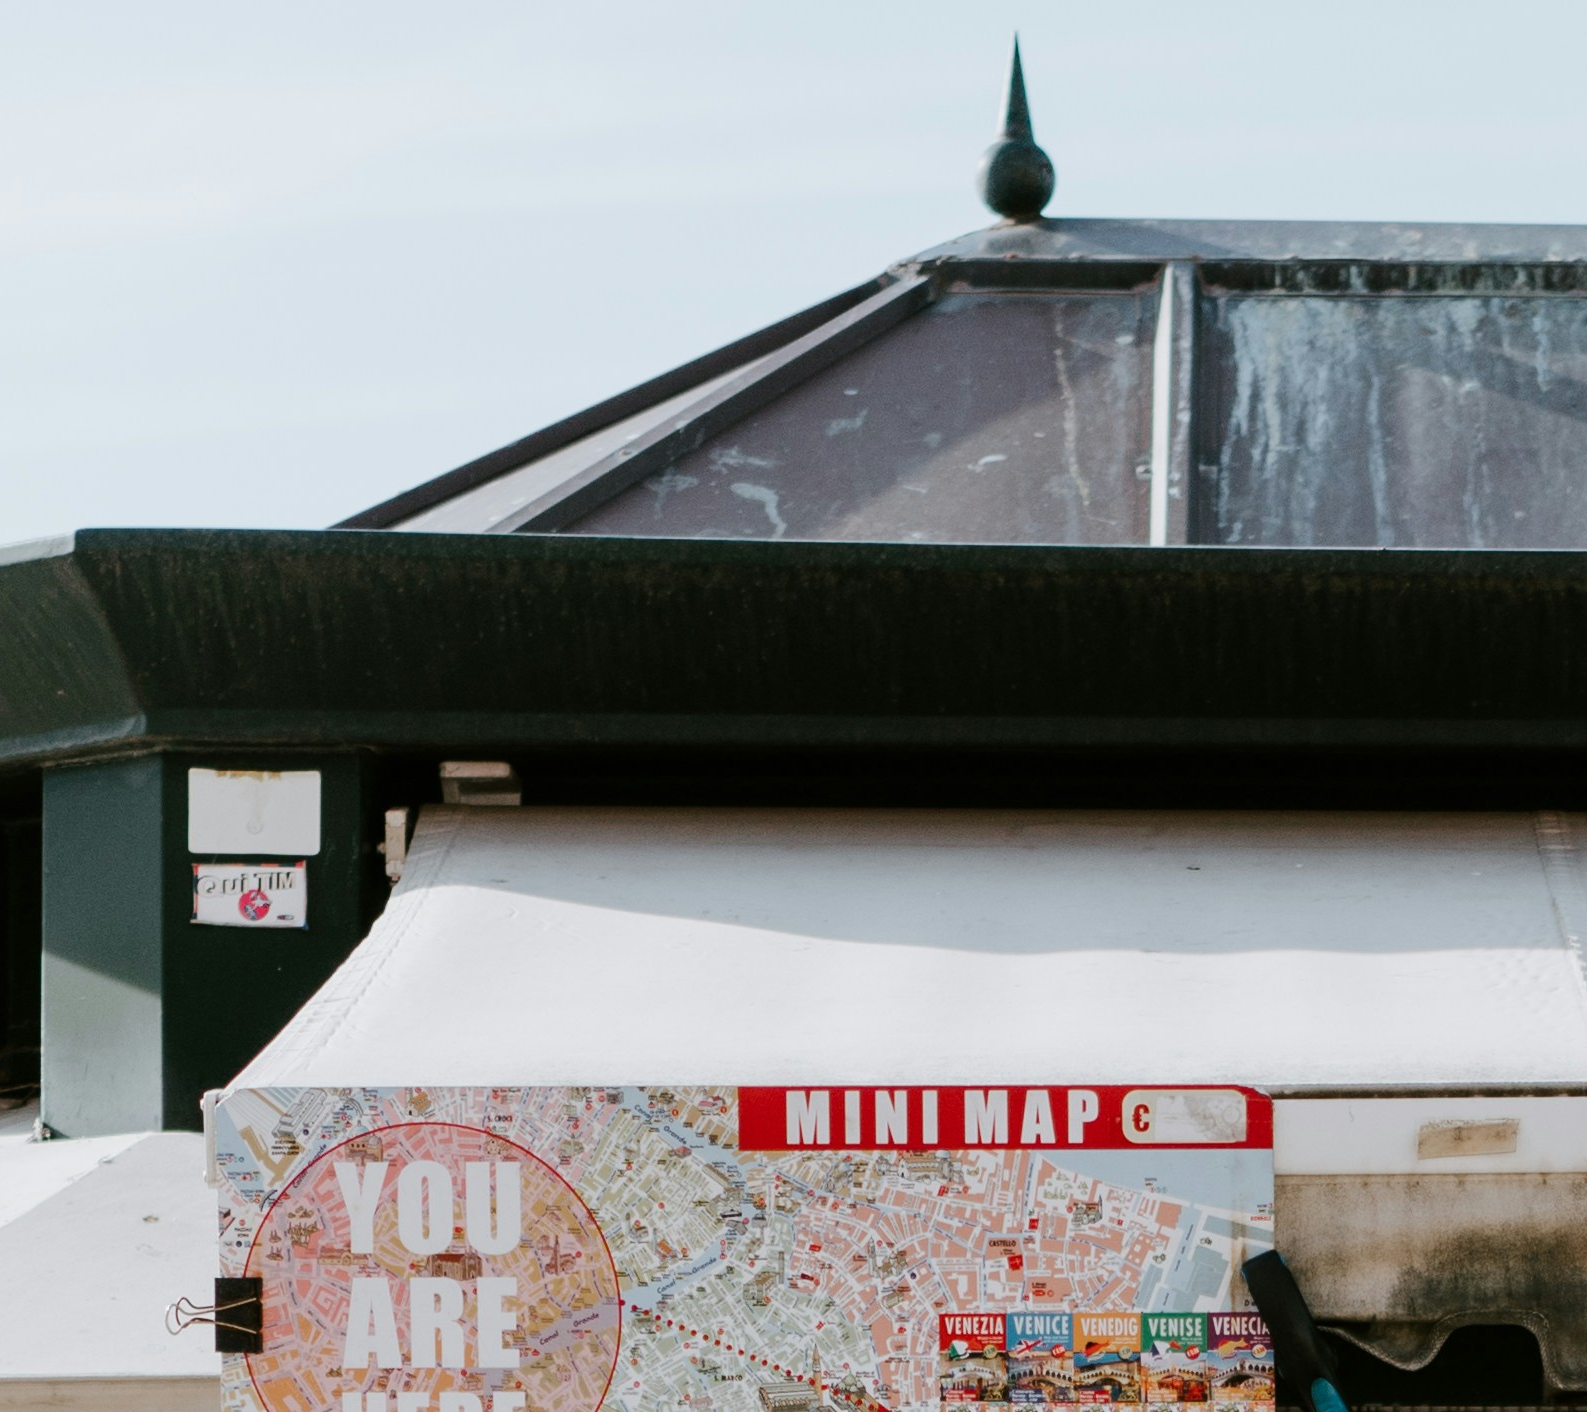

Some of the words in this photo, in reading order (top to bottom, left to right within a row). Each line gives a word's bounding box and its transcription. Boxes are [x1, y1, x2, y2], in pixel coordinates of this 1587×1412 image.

[253, 872, 295, 890] TIM
[786, 1090, 937, 1144] MINI
[964, 1090, 1098, 1143] MAP
[1132, 1103, 1150, 1132] €
[333, 1161, 520, 1255] YOU
[345, 1277, 519, 1368] ARE
[945, 1316, 1004, 1335] VENEZIA
[1013, 1316, 1070, 1335] VENICE
[1081, 1318, 1138, 1337] VENEDIG
[1148, 1317, 1203, 1337] VENISE
